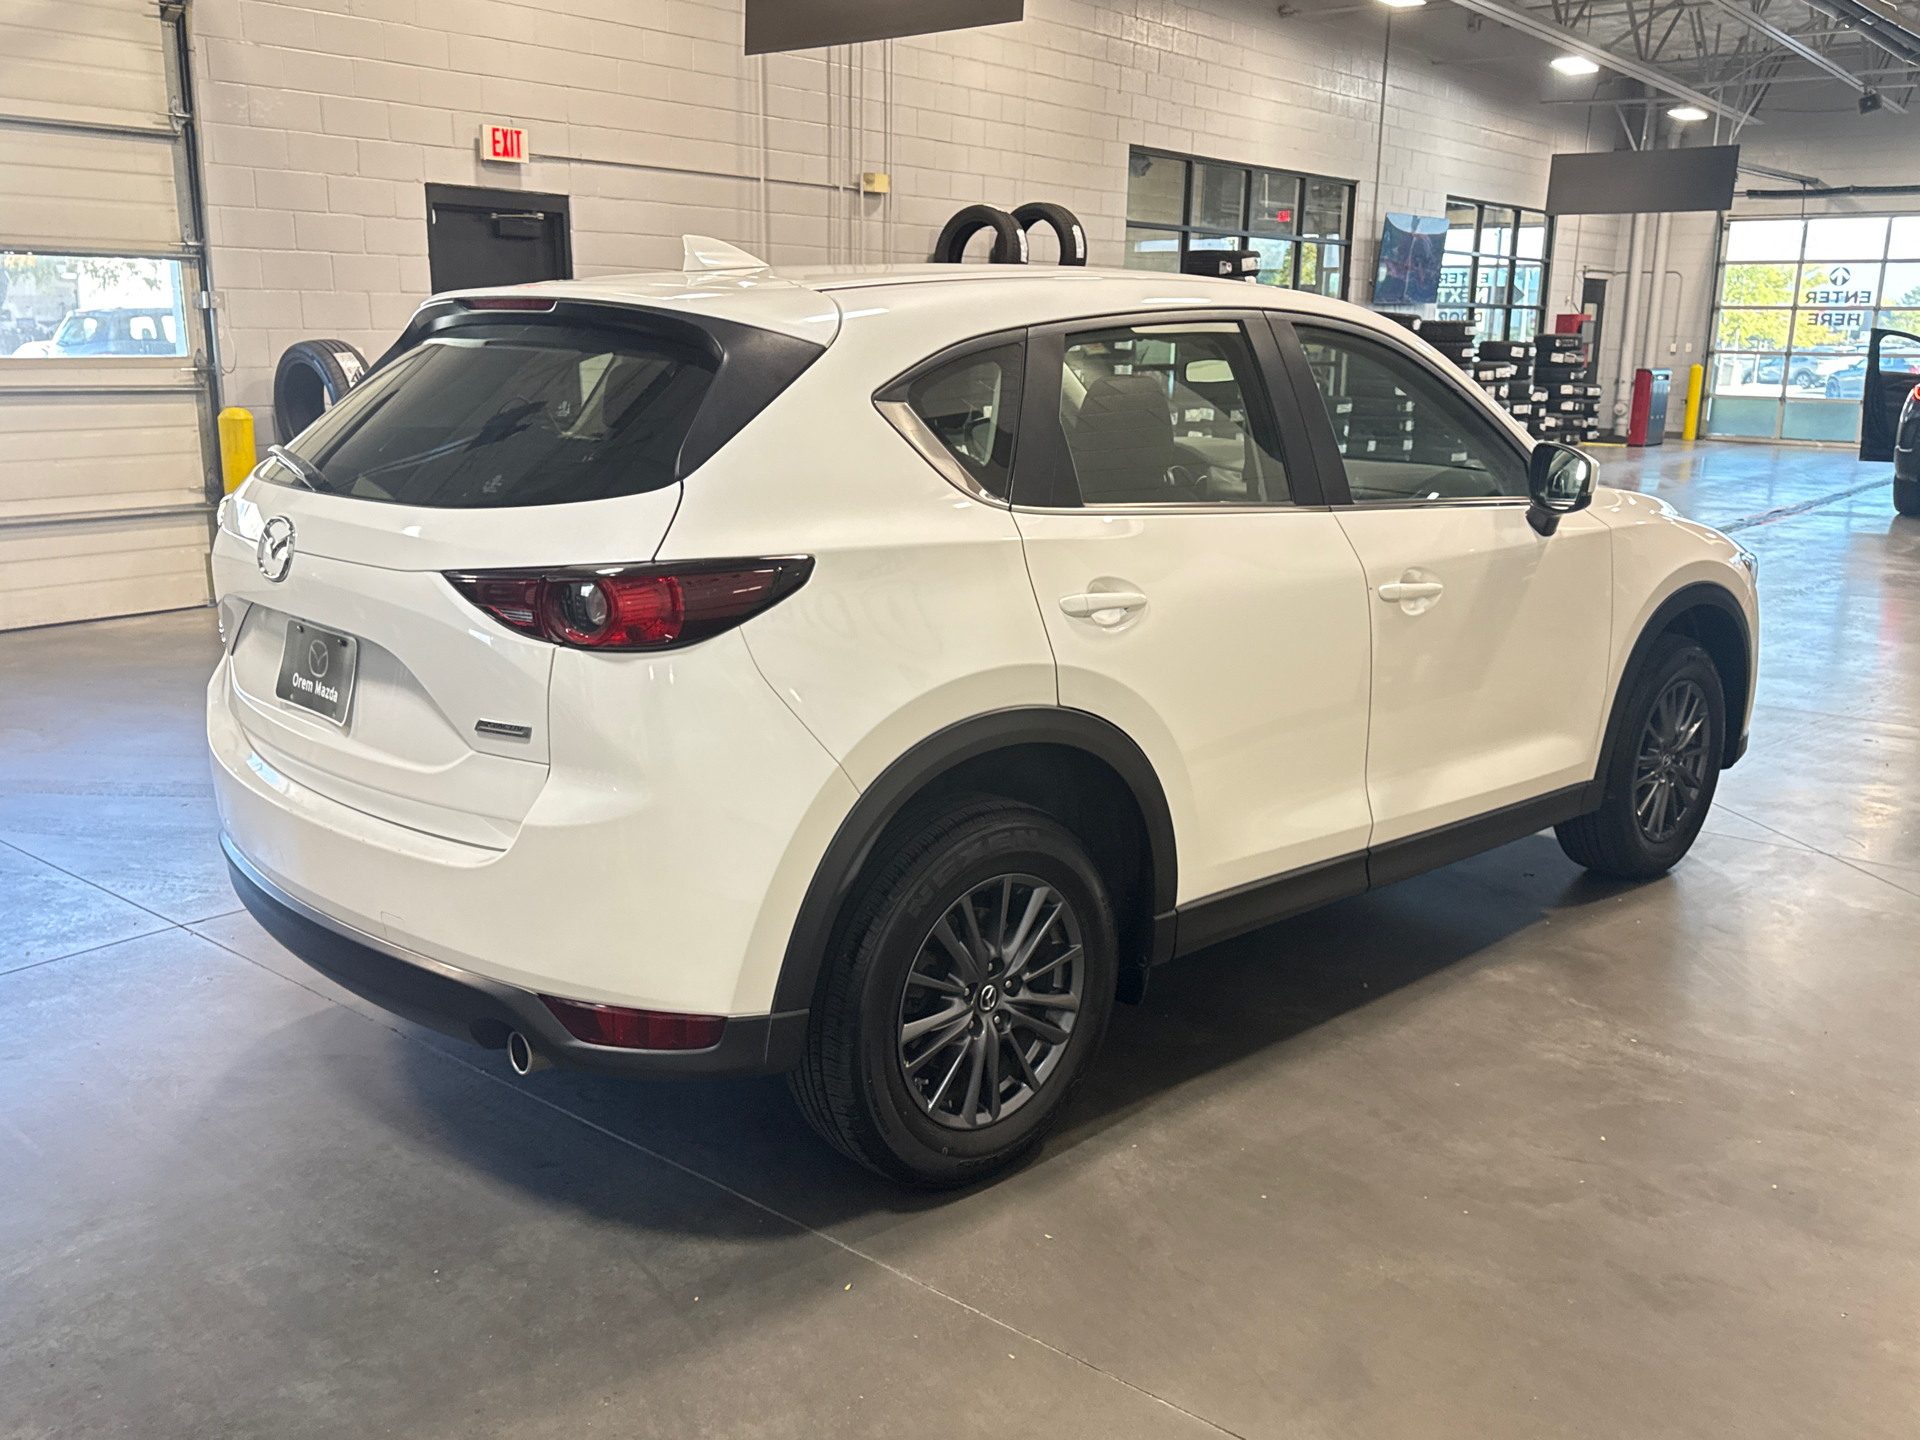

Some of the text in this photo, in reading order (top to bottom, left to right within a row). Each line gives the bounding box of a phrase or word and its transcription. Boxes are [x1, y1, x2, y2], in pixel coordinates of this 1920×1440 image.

[491, 127, 522, 159] EXIT
[292, 672, 338, 702] Orem Mazda
[907, 829, 1038, 918] NEXEN
